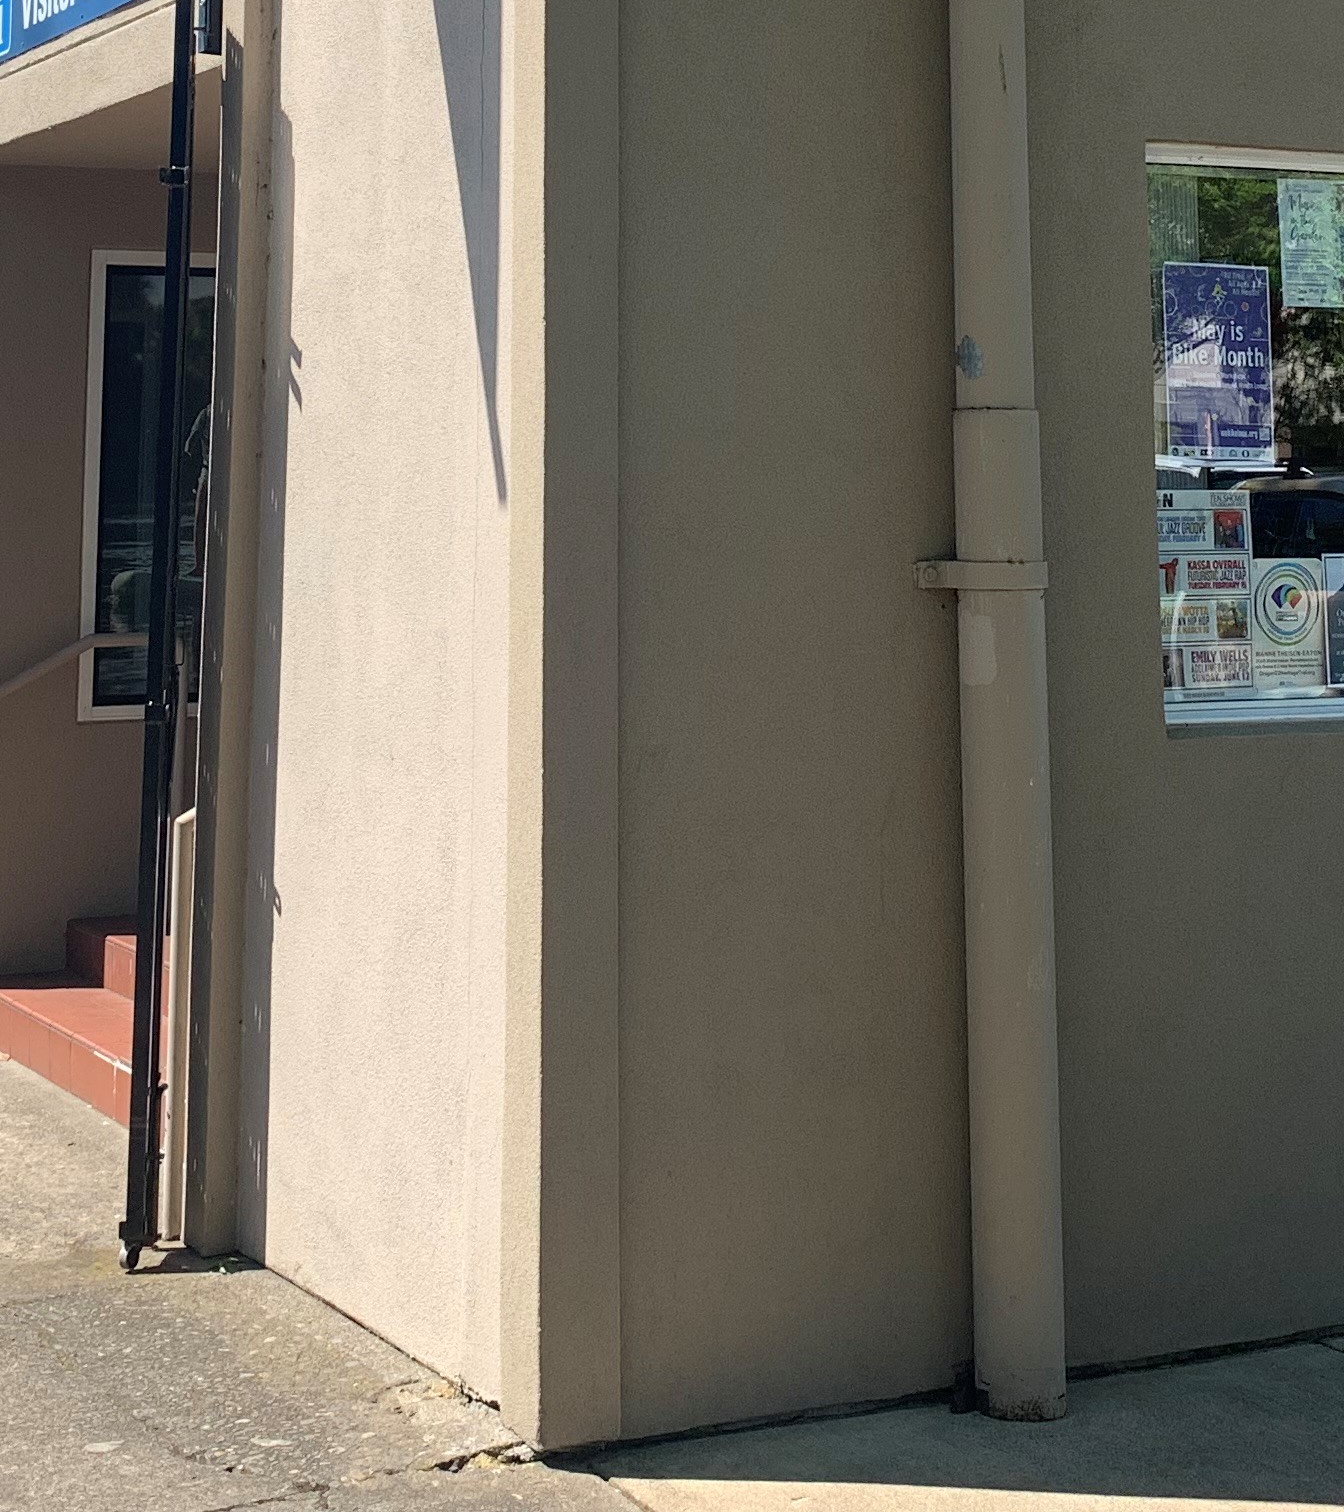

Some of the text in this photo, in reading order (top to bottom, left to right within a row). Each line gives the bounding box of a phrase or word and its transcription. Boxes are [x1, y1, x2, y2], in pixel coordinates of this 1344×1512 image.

[1192, 319, 1244, 345] May is
[1172, 343, 1265, 367] Bike Month
[1166, 522, 1180, 535] JAZZ
[1187, 559, 1246, 570] KASSA OVERALL
[1220, 570, 1233, 581] JAZZ
[1234, 569, 1247, 580] RAP
[1191, 649, 1249, 663] EMILY WELLS
